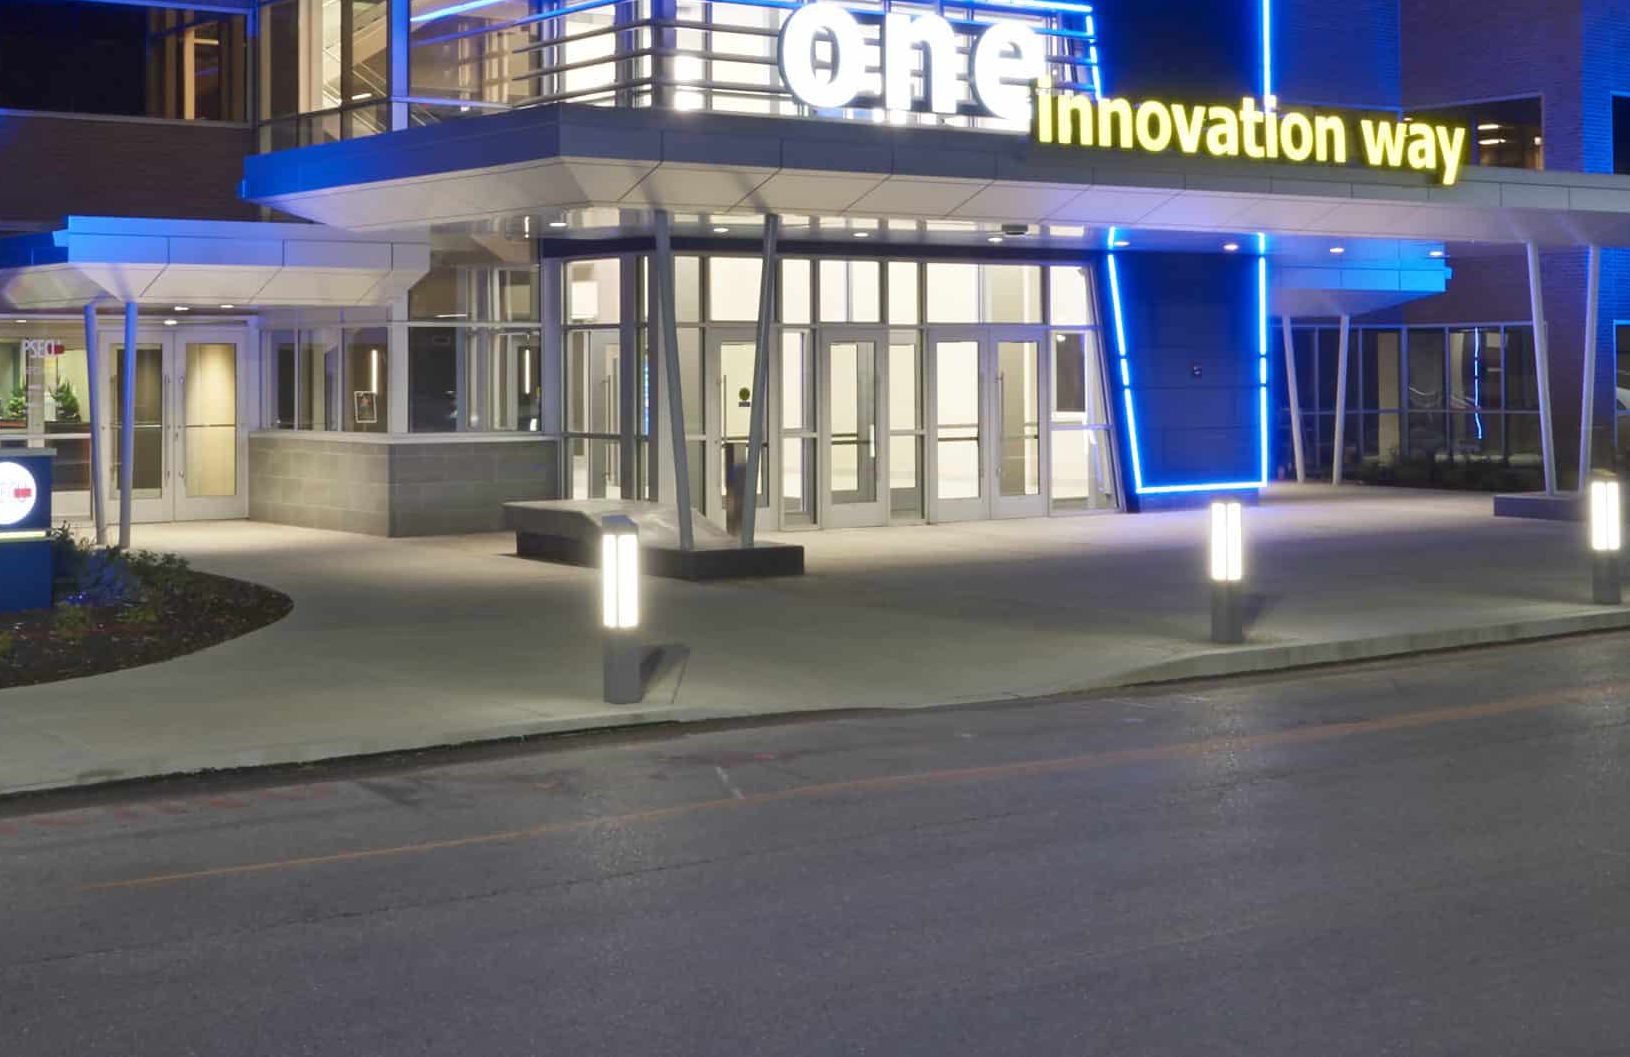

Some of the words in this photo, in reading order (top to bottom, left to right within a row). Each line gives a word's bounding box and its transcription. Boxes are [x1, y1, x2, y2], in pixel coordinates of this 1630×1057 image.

[780, 3, 1048, 122] one
[1037, 76, 1346, 163] innovation
[1360, 119, 1466, 186] way
